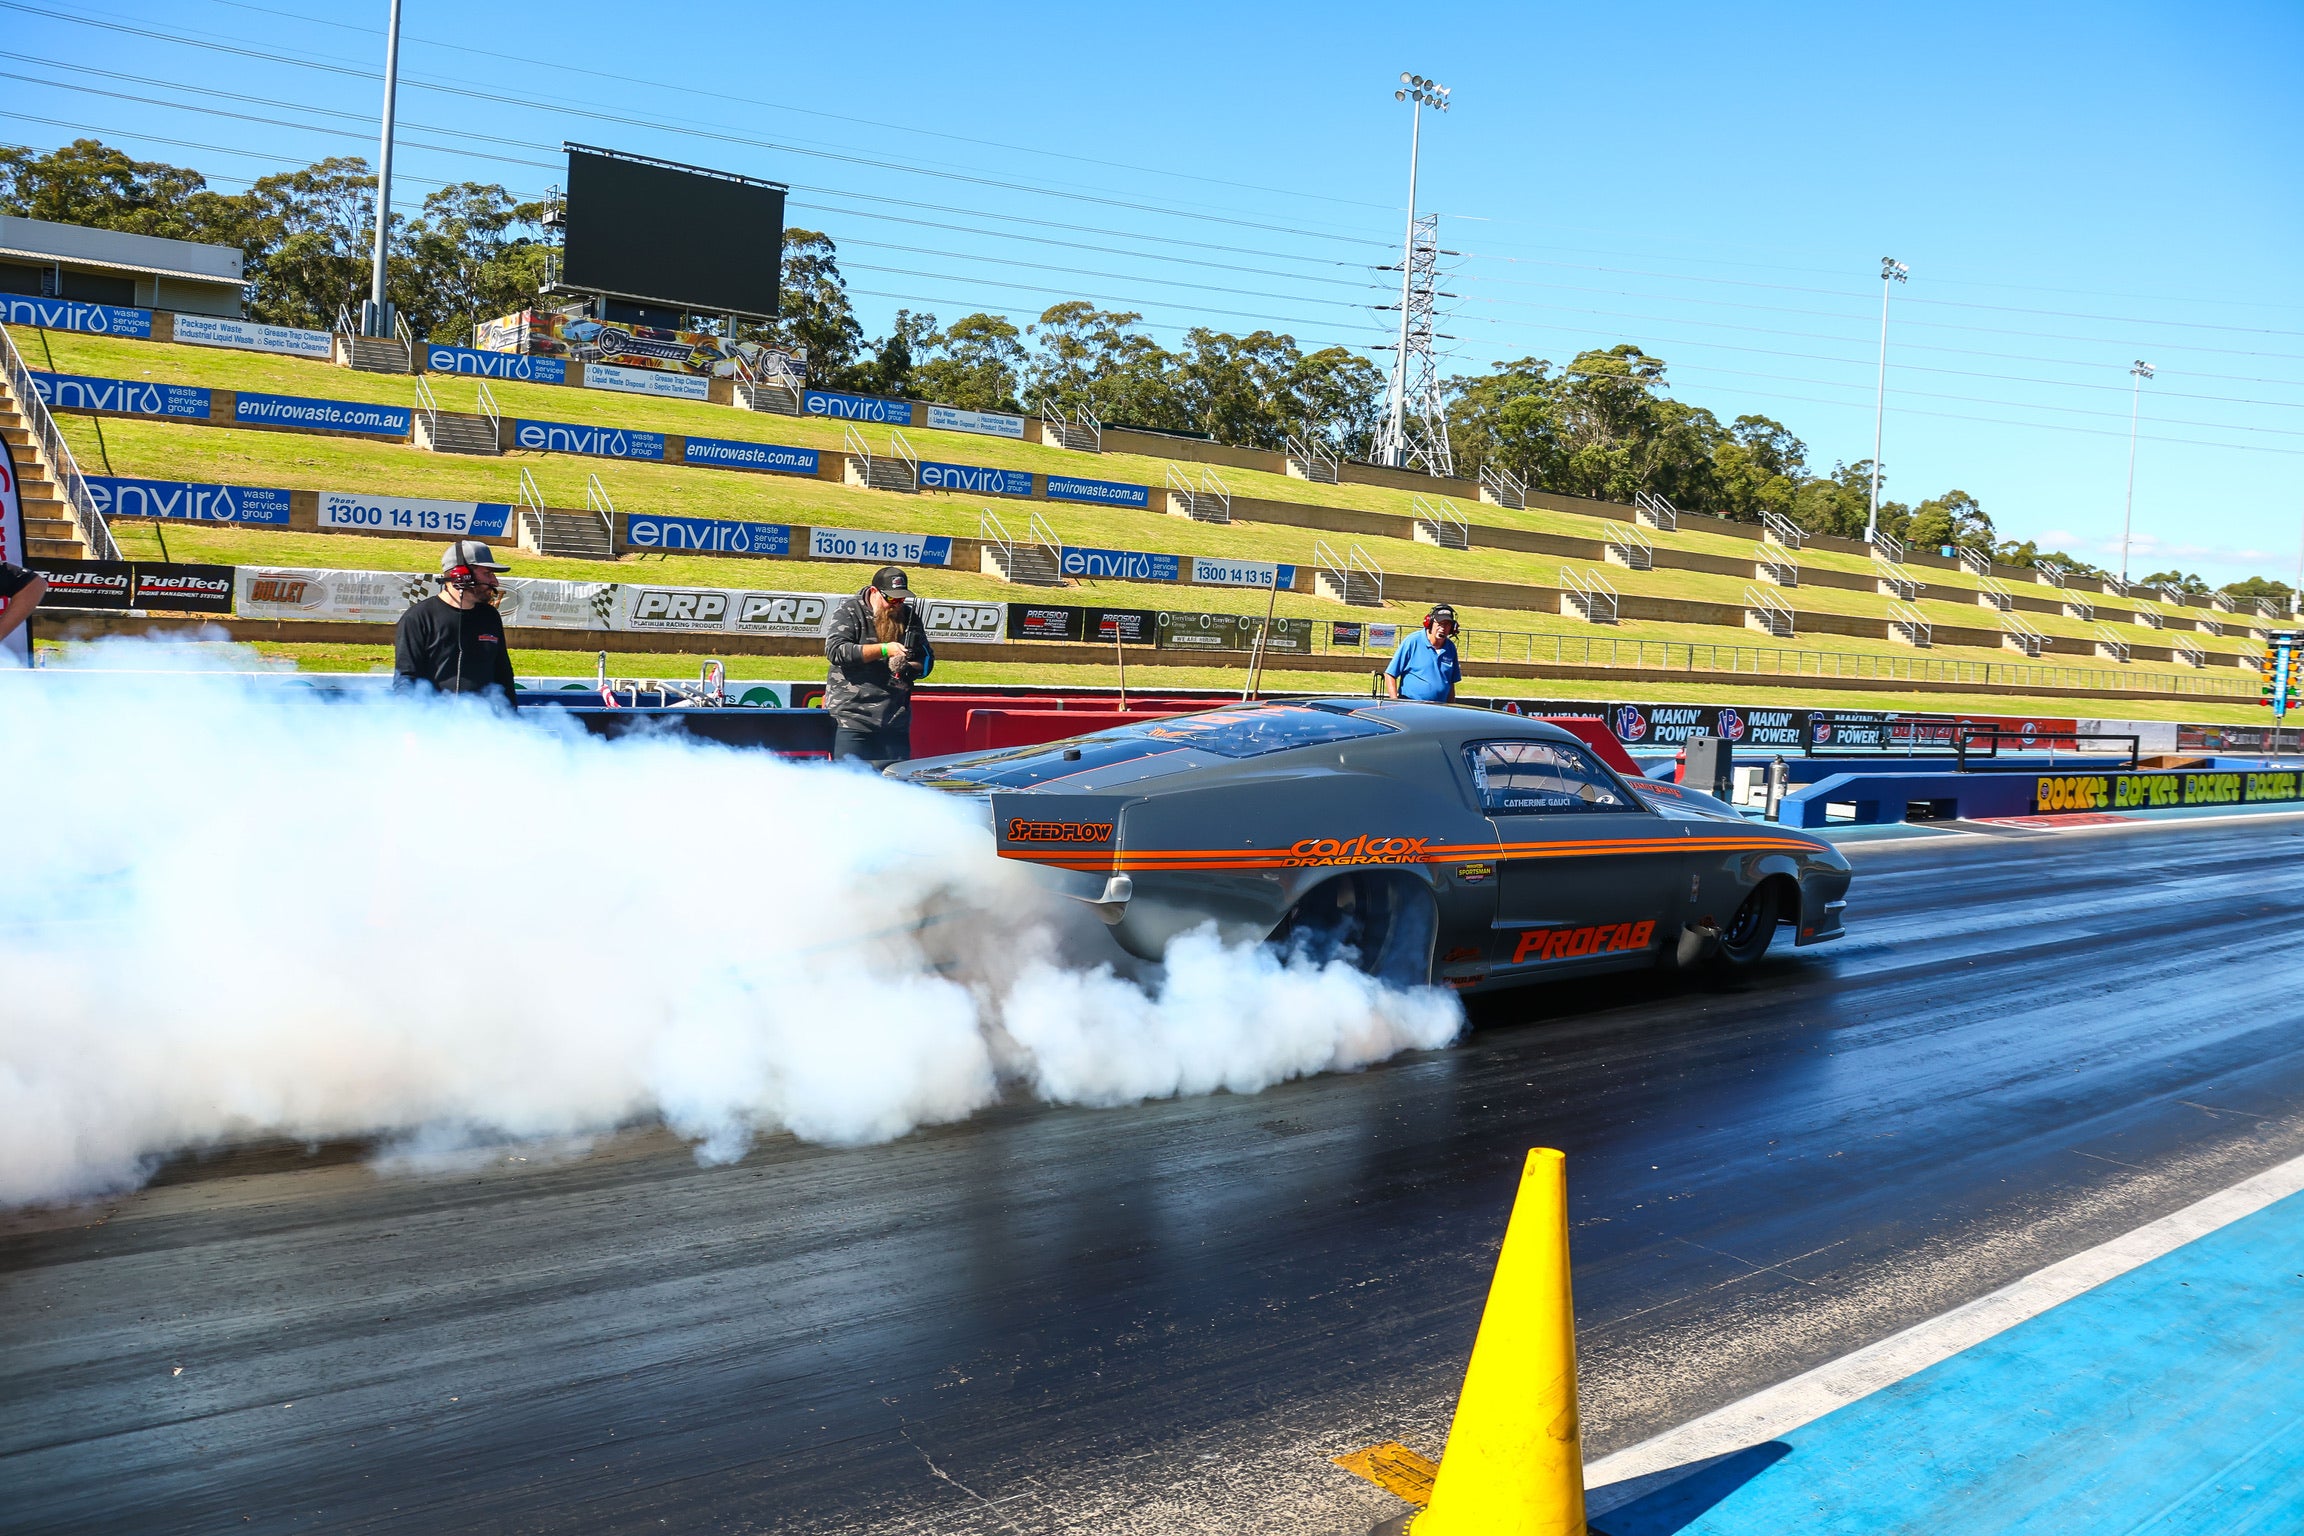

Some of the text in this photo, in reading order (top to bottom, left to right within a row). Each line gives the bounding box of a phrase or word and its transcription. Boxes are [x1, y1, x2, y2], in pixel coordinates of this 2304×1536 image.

[0, 300, 107, 332] nviro
[113, 309, 139, 318] waste
[112, 318, 150, 327] services
[181, 318, 243, 333] Packaged Waste
[112, 325, 138, 334] group
[180, 328, 254, 344] Industrial Liquid Waste
[264, 328, 331, 344] Grease Trap Cleaning
[263, 338, 329, 354] Septic Tank Cleaning
[535, 358, 556, 367] waste
[534, 372, 555, 380] group
[535, 365, 564, 374] services
[604, 368, 621, 377] Water
[592, 375, 646, 388] Liquid Waste Disposal
[654, 374, 707, 388] Grease Trap Cleaning
[168, 387, 197, 397] waste
[654, 383, 706, 396] Septic Tank Cleaning
[167, 396, 209, 407] services
[167, 404, 195, 414] group
[237, 400, 404, 428] envirowaste.com.au
[887, 409, 911, 417] services
[631, 433, 654, 441] waste
[631, 440, 663, 450] services
[631, 448, 653, 456] group
[686, 443, 813, 467] envirowaste.com.au
[1007, 479, 1031, 487] services
[243, 490, 275, 500] waste
[1048, 481, 1144, 501] envirowaste.com.au
[242, 500, 289, 511] services
[242, 510, 273, 521] group
[327, 505, 467, 530] 1300 14 13 15
[754, 526, 779, 534] waste
[754, 534, 789, 543] services
[753, 542, 777, 551] group
[815, 538, 920, 559] 1300 14 13 15
[1152, 563, 1178, 571] services
[1197, 566, 1272, 584] 1300 14 13 15
[140, 575, 230, 592] FuelTech
[373, 585, 386, 595] OF
[252, 581, 308, 603] BULLET
[636, 593, 726, 620] PRP
[740, 597, 825, 623] PRP
[927, 606, 999, 630] PRP
[1027, 610, 1068, 619] PRECISION
[1102, 613, 1141, 622] PRECISION
[1650, 709, 1701, 725] MAKIN'
[1748, 711, 1792, 727] MAKIN'
[1654, 726, 1710, 741] POWER!
[1751, 728, 1800, 743] POWER!
[1837, 730, 1879, 744] POWER!
[1503, 798, 1570, 807] CATHERINE GAUCI
[1008, 818, 1113, 842] SPEEDFLOW
[1290, 834, 1430, 857] carlcox
[1280, 855, 1432, 868] DRAGRACING
[1458, 868, 1491, 876] SPORTSMAN
[1512, 920, 1656, 964] PROFAB
